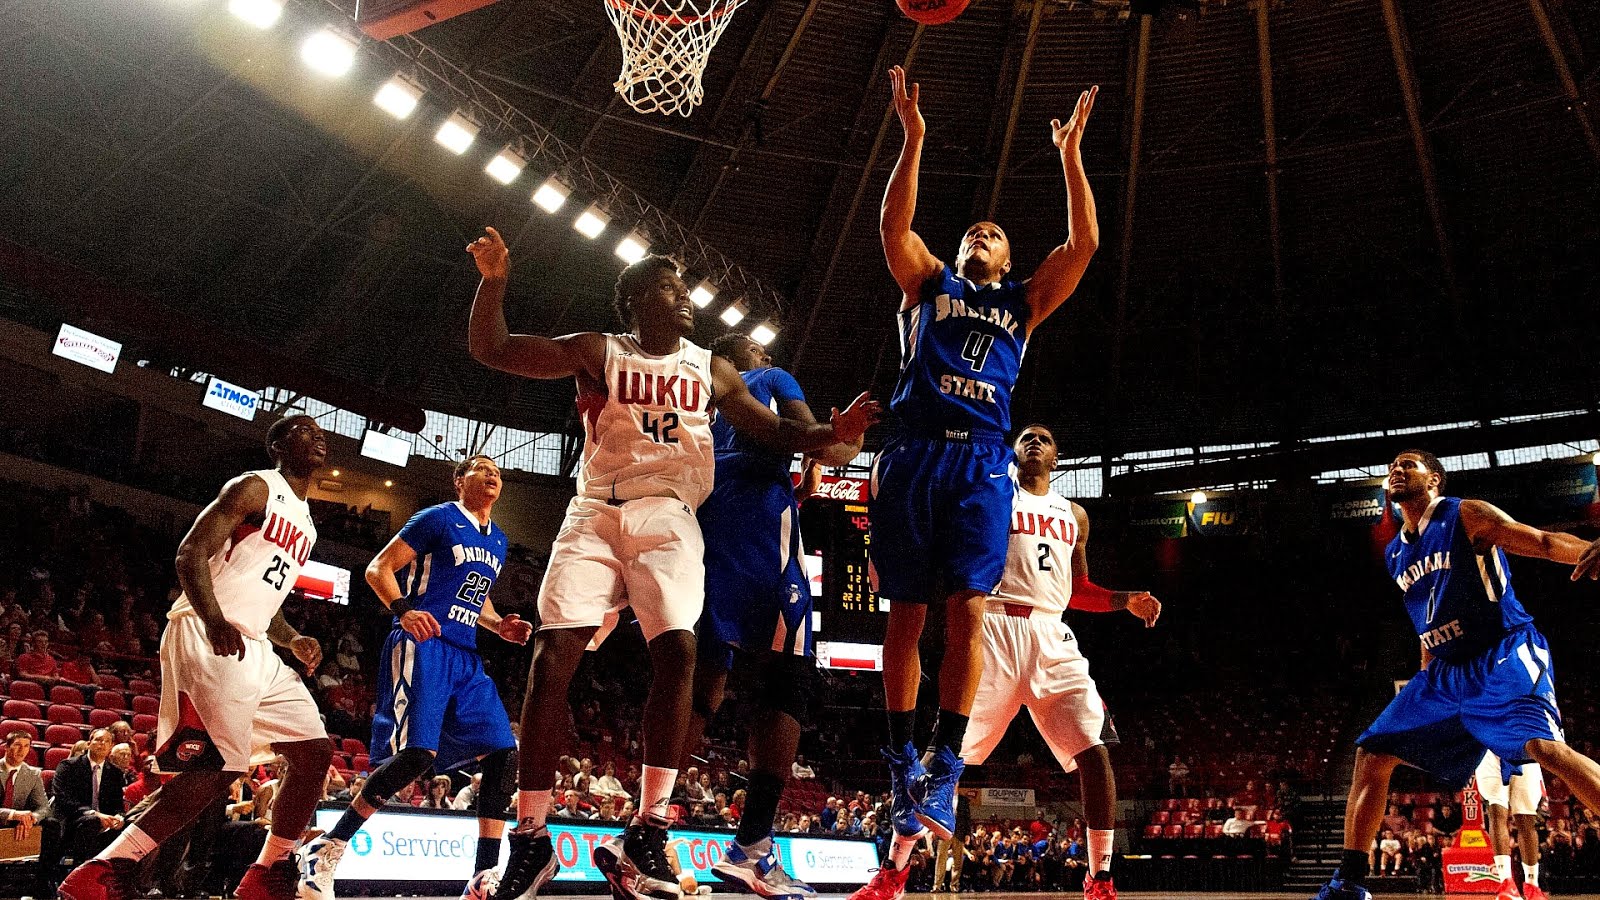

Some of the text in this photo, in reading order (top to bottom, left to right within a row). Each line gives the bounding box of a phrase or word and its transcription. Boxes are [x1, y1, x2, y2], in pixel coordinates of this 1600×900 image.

[961, 331, 994, 373] 4
[210, 382, 256, 408] ATMOS
[618, 370, 700, 413] WKU
[940, 375, 996, 404] STATE
[642, 411, 679, 443] 42
[851, 516, 869, 530] 42
[1009, 511, 1075, 547] WKU
[1201, 511, 1235, 526] FIU
[263, 512, 311, 567] WKU
[1037, 542, 1052, 572] 2
[262, 555, 291, 591] 25
[456, 570, 492, 608] 22
[842, 592, 854, 602] 22
[988, 788, 1028, 798] EQUIPMENT
[1448, 865, 1490, 873] Crossroads
